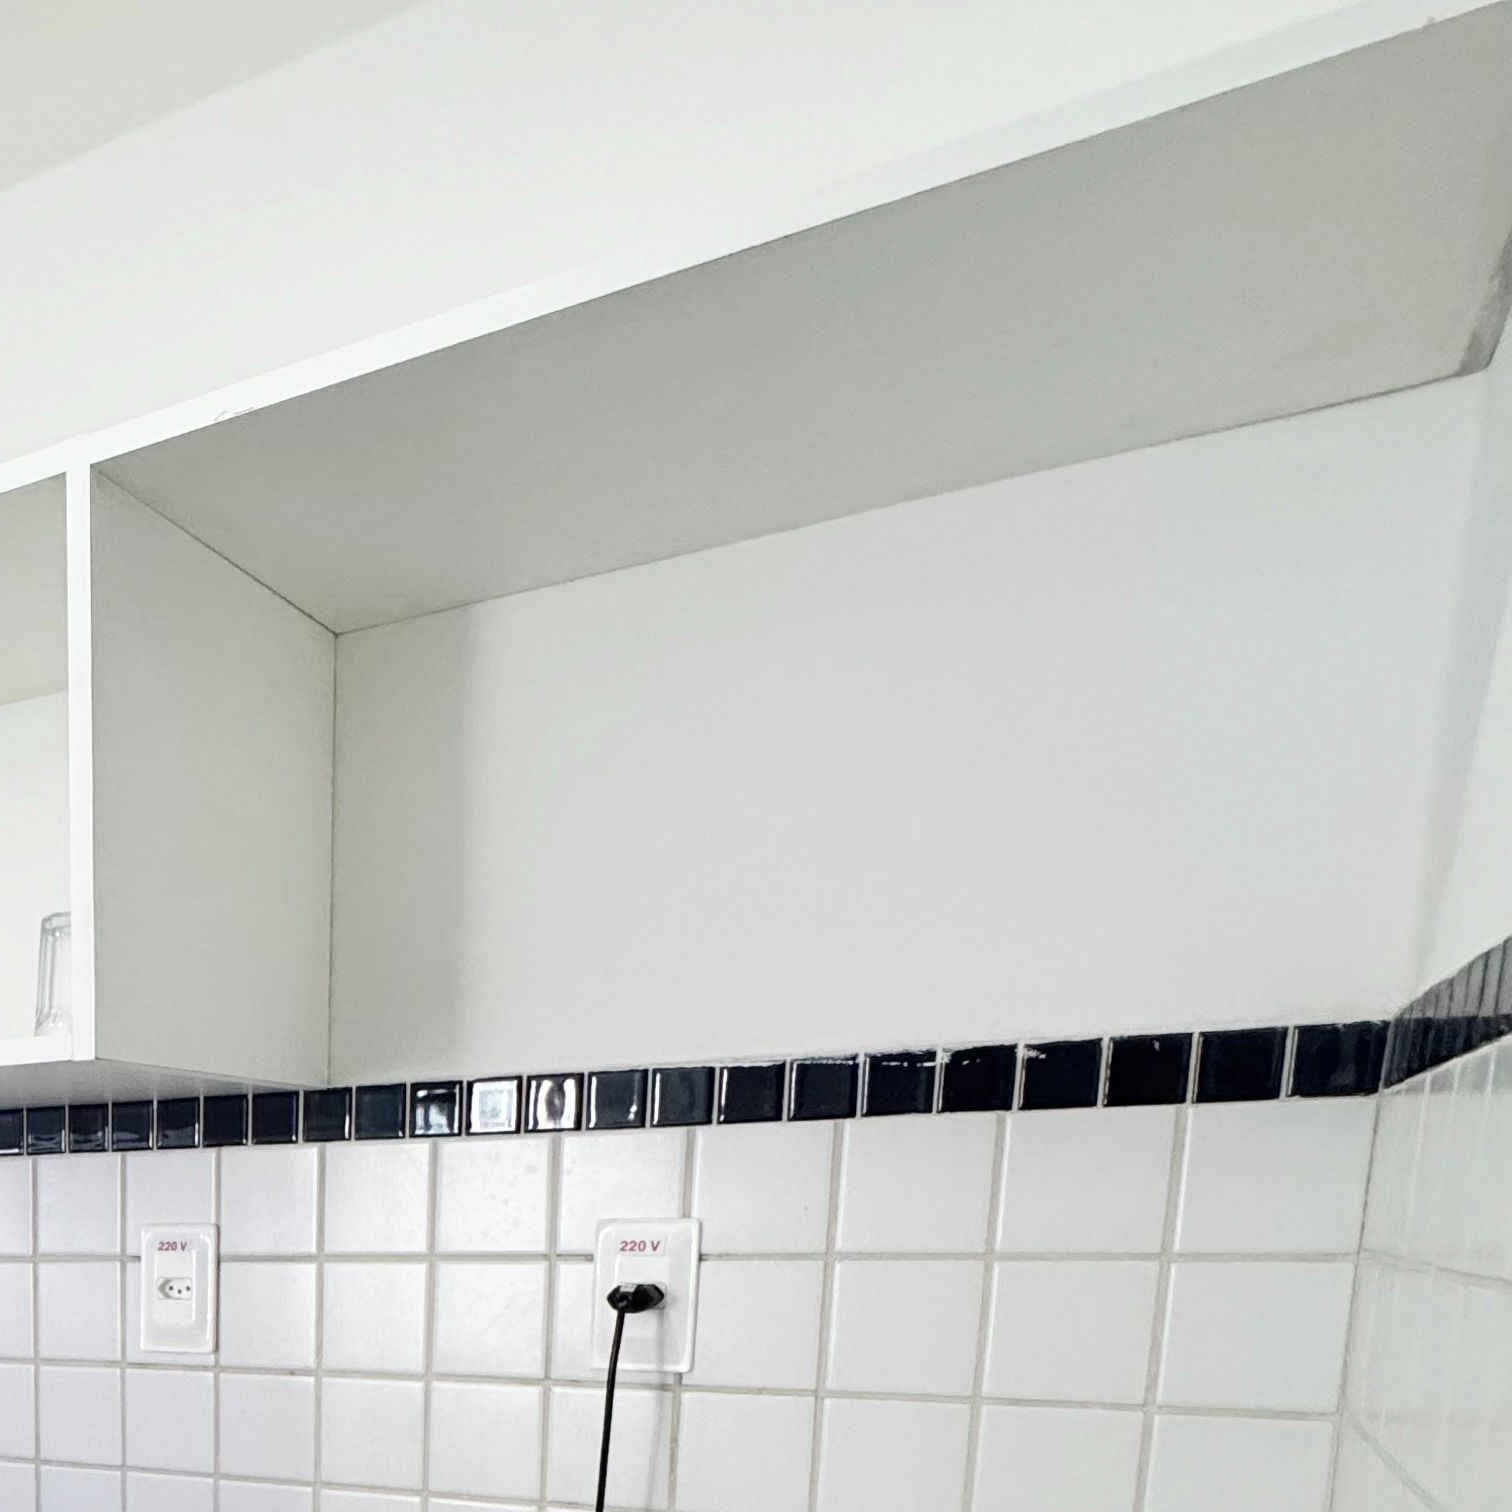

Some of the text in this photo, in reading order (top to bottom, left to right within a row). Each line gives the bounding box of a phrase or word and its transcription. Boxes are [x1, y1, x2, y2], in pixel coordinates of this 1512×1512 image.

[158, 1241, 189, 1252] 220 V
[619, 1240, 661, 1252] 220 V
